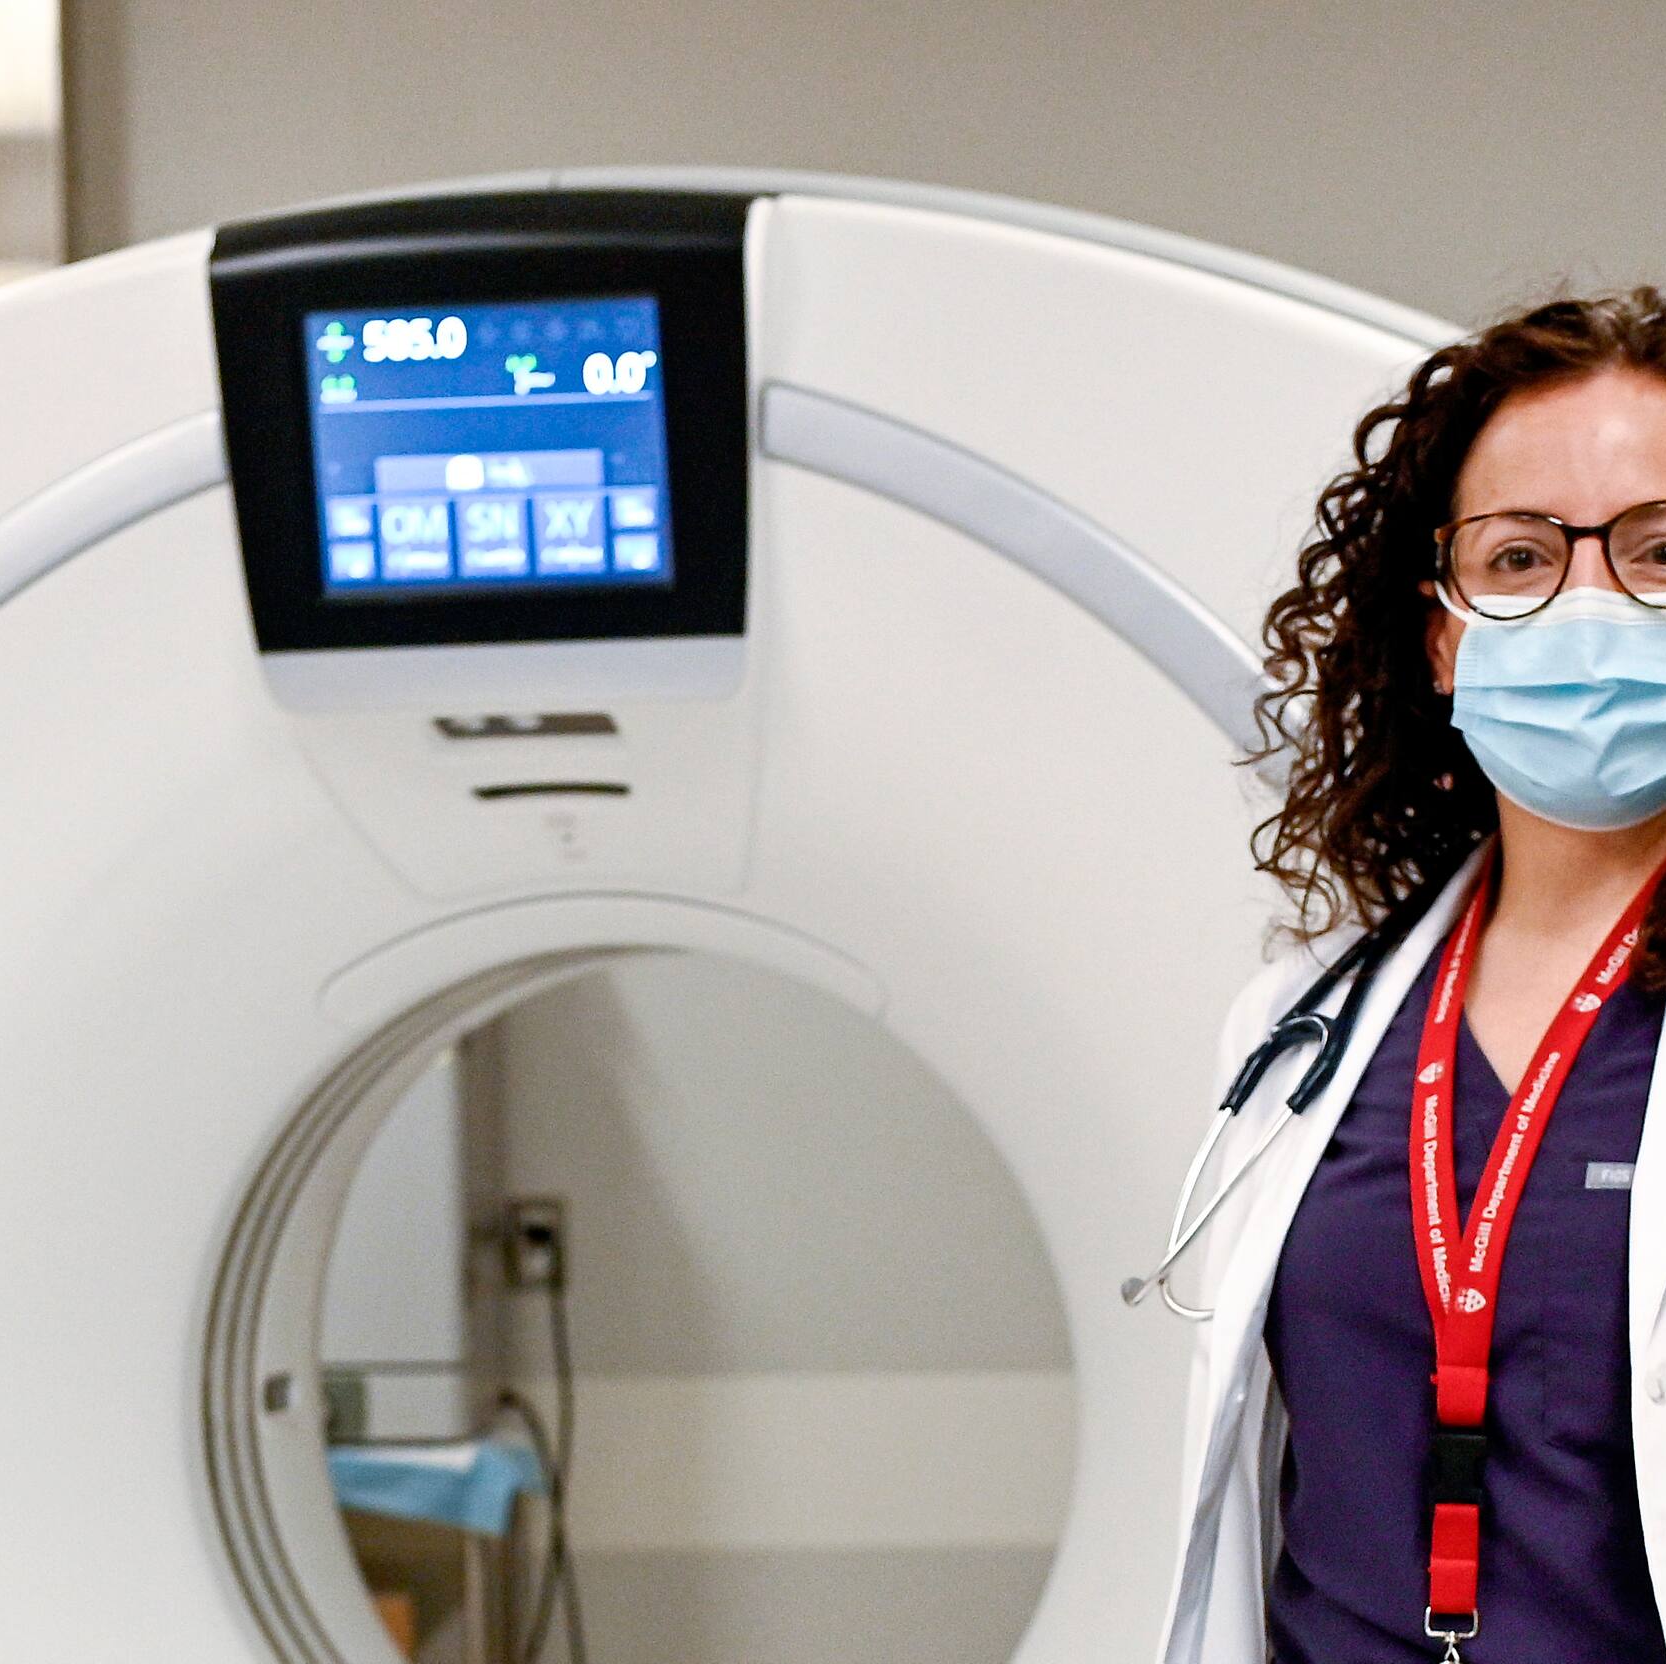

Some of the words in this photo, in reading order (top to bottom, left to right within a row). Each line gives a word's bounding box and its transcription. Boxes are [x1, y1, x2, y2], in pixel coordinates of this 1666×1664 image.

[1521, 1051, 1561, 1113] Medicine
[1517, 1114, 1531, 1131] of
[1422, 1140, 1441, 1226] Department
[1482, 1133, 1524, 1219] Department
[1430, 1228, 1445, 1244] of
[1469, 1221, 1493, 1272] McGill
